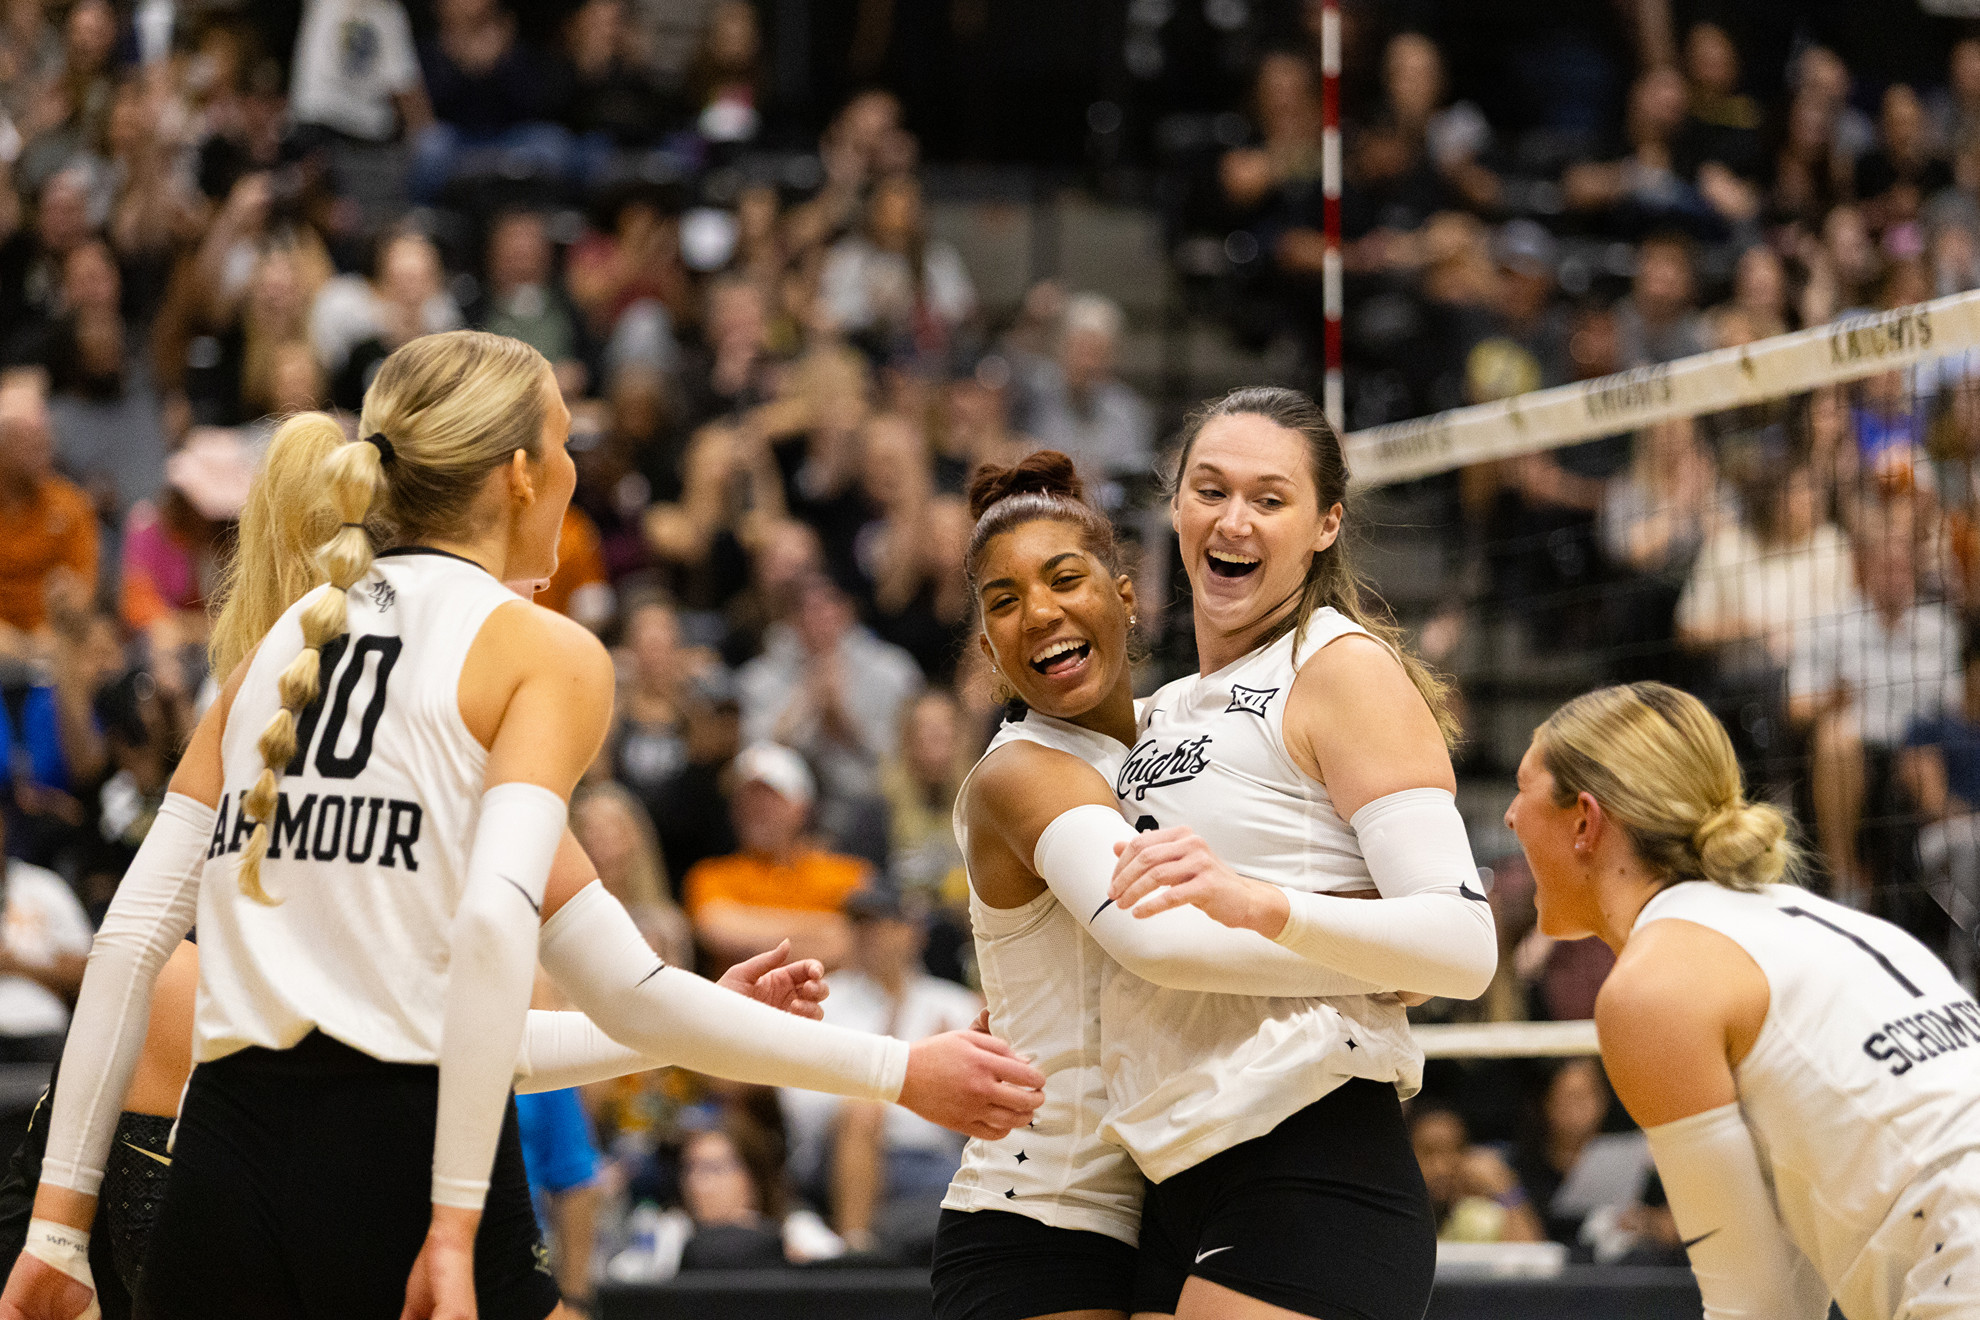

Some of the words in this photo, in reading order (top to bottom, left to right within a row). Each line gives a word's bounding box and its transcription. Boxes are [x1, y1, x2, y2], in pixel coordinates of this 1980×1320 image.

[284, 632, 403, 780] 10
[1117, 734, 1213, 801] Knights
[1778, 905, 1926, 999] 1
